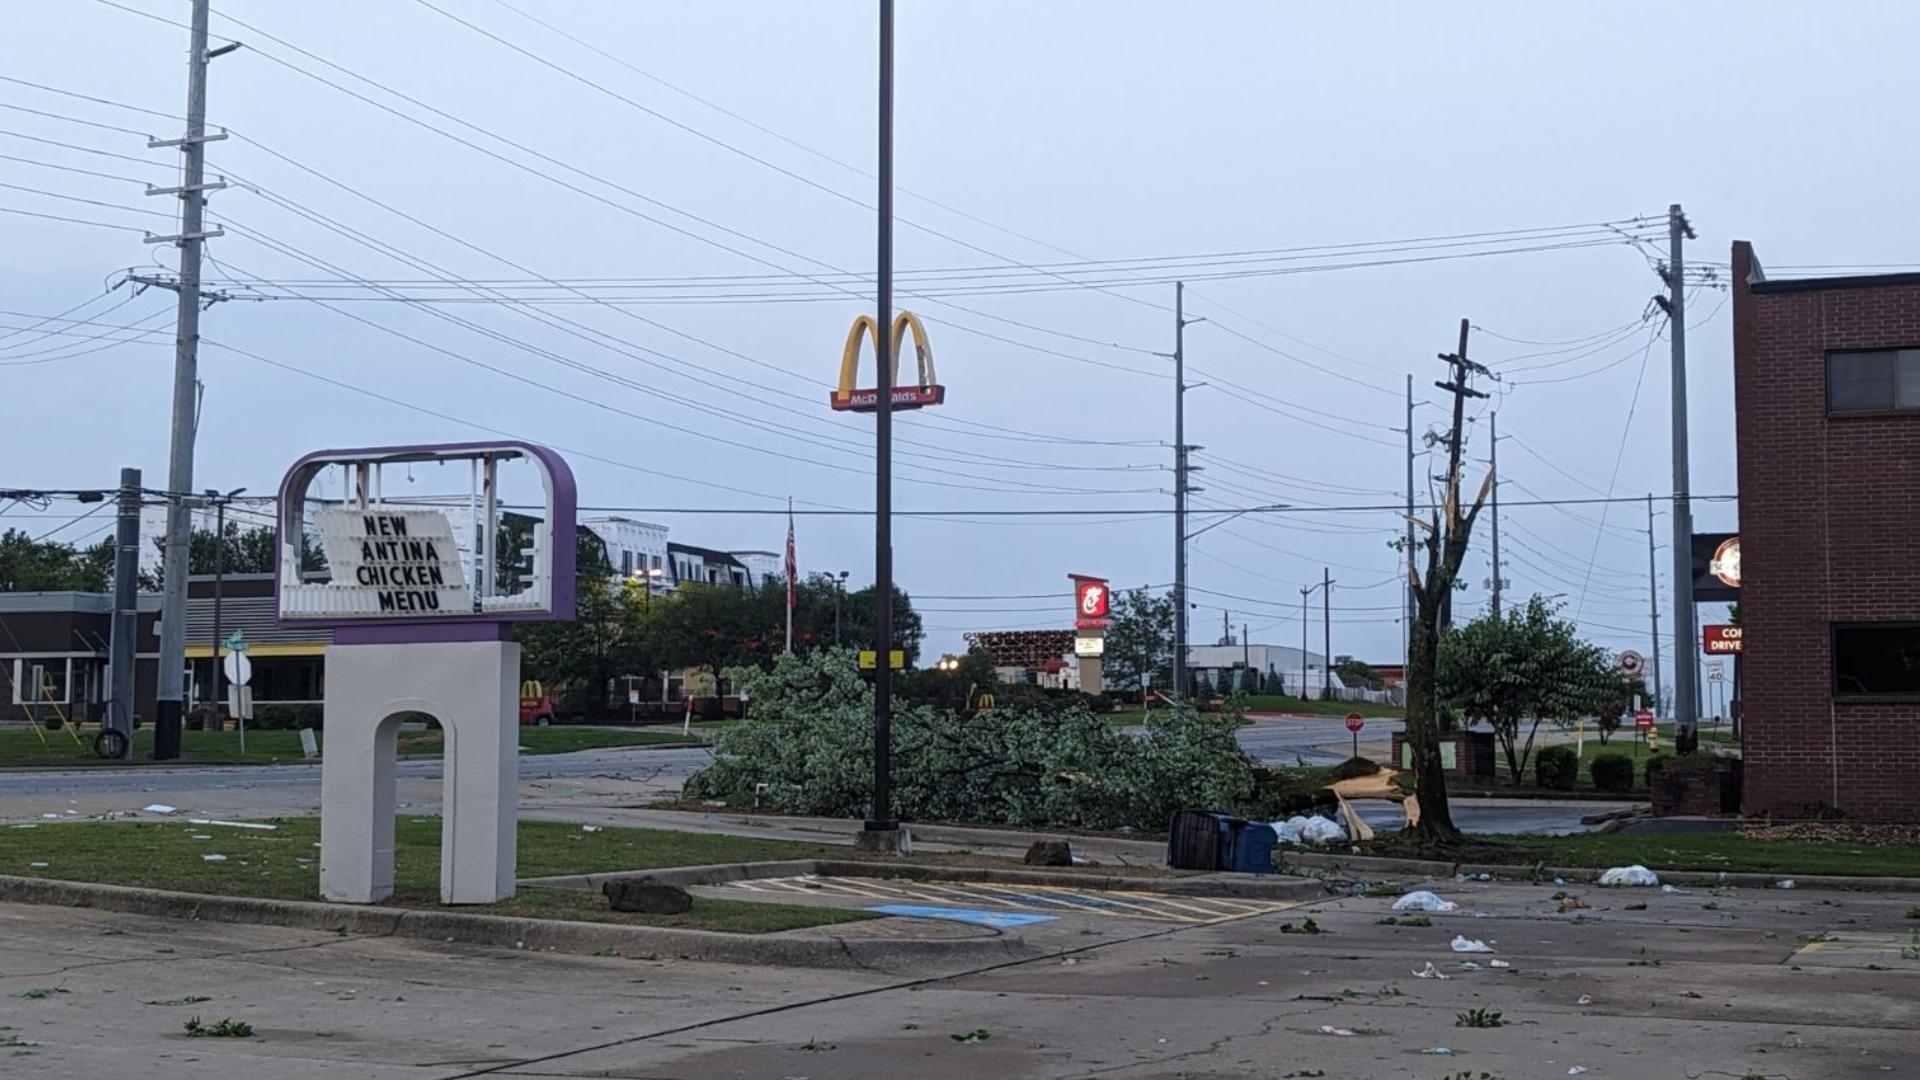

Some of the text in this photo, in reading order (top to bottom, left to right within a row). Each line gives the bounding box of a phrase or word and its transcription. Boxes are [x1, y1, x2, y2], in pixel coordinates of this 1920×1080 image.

[851, 392, 917, 405] McDald's
[363, 515, 408, 536] NEW
[362, 541, 440, 561] ANTINA
[356, 565, 444, 586] CHICKEN
